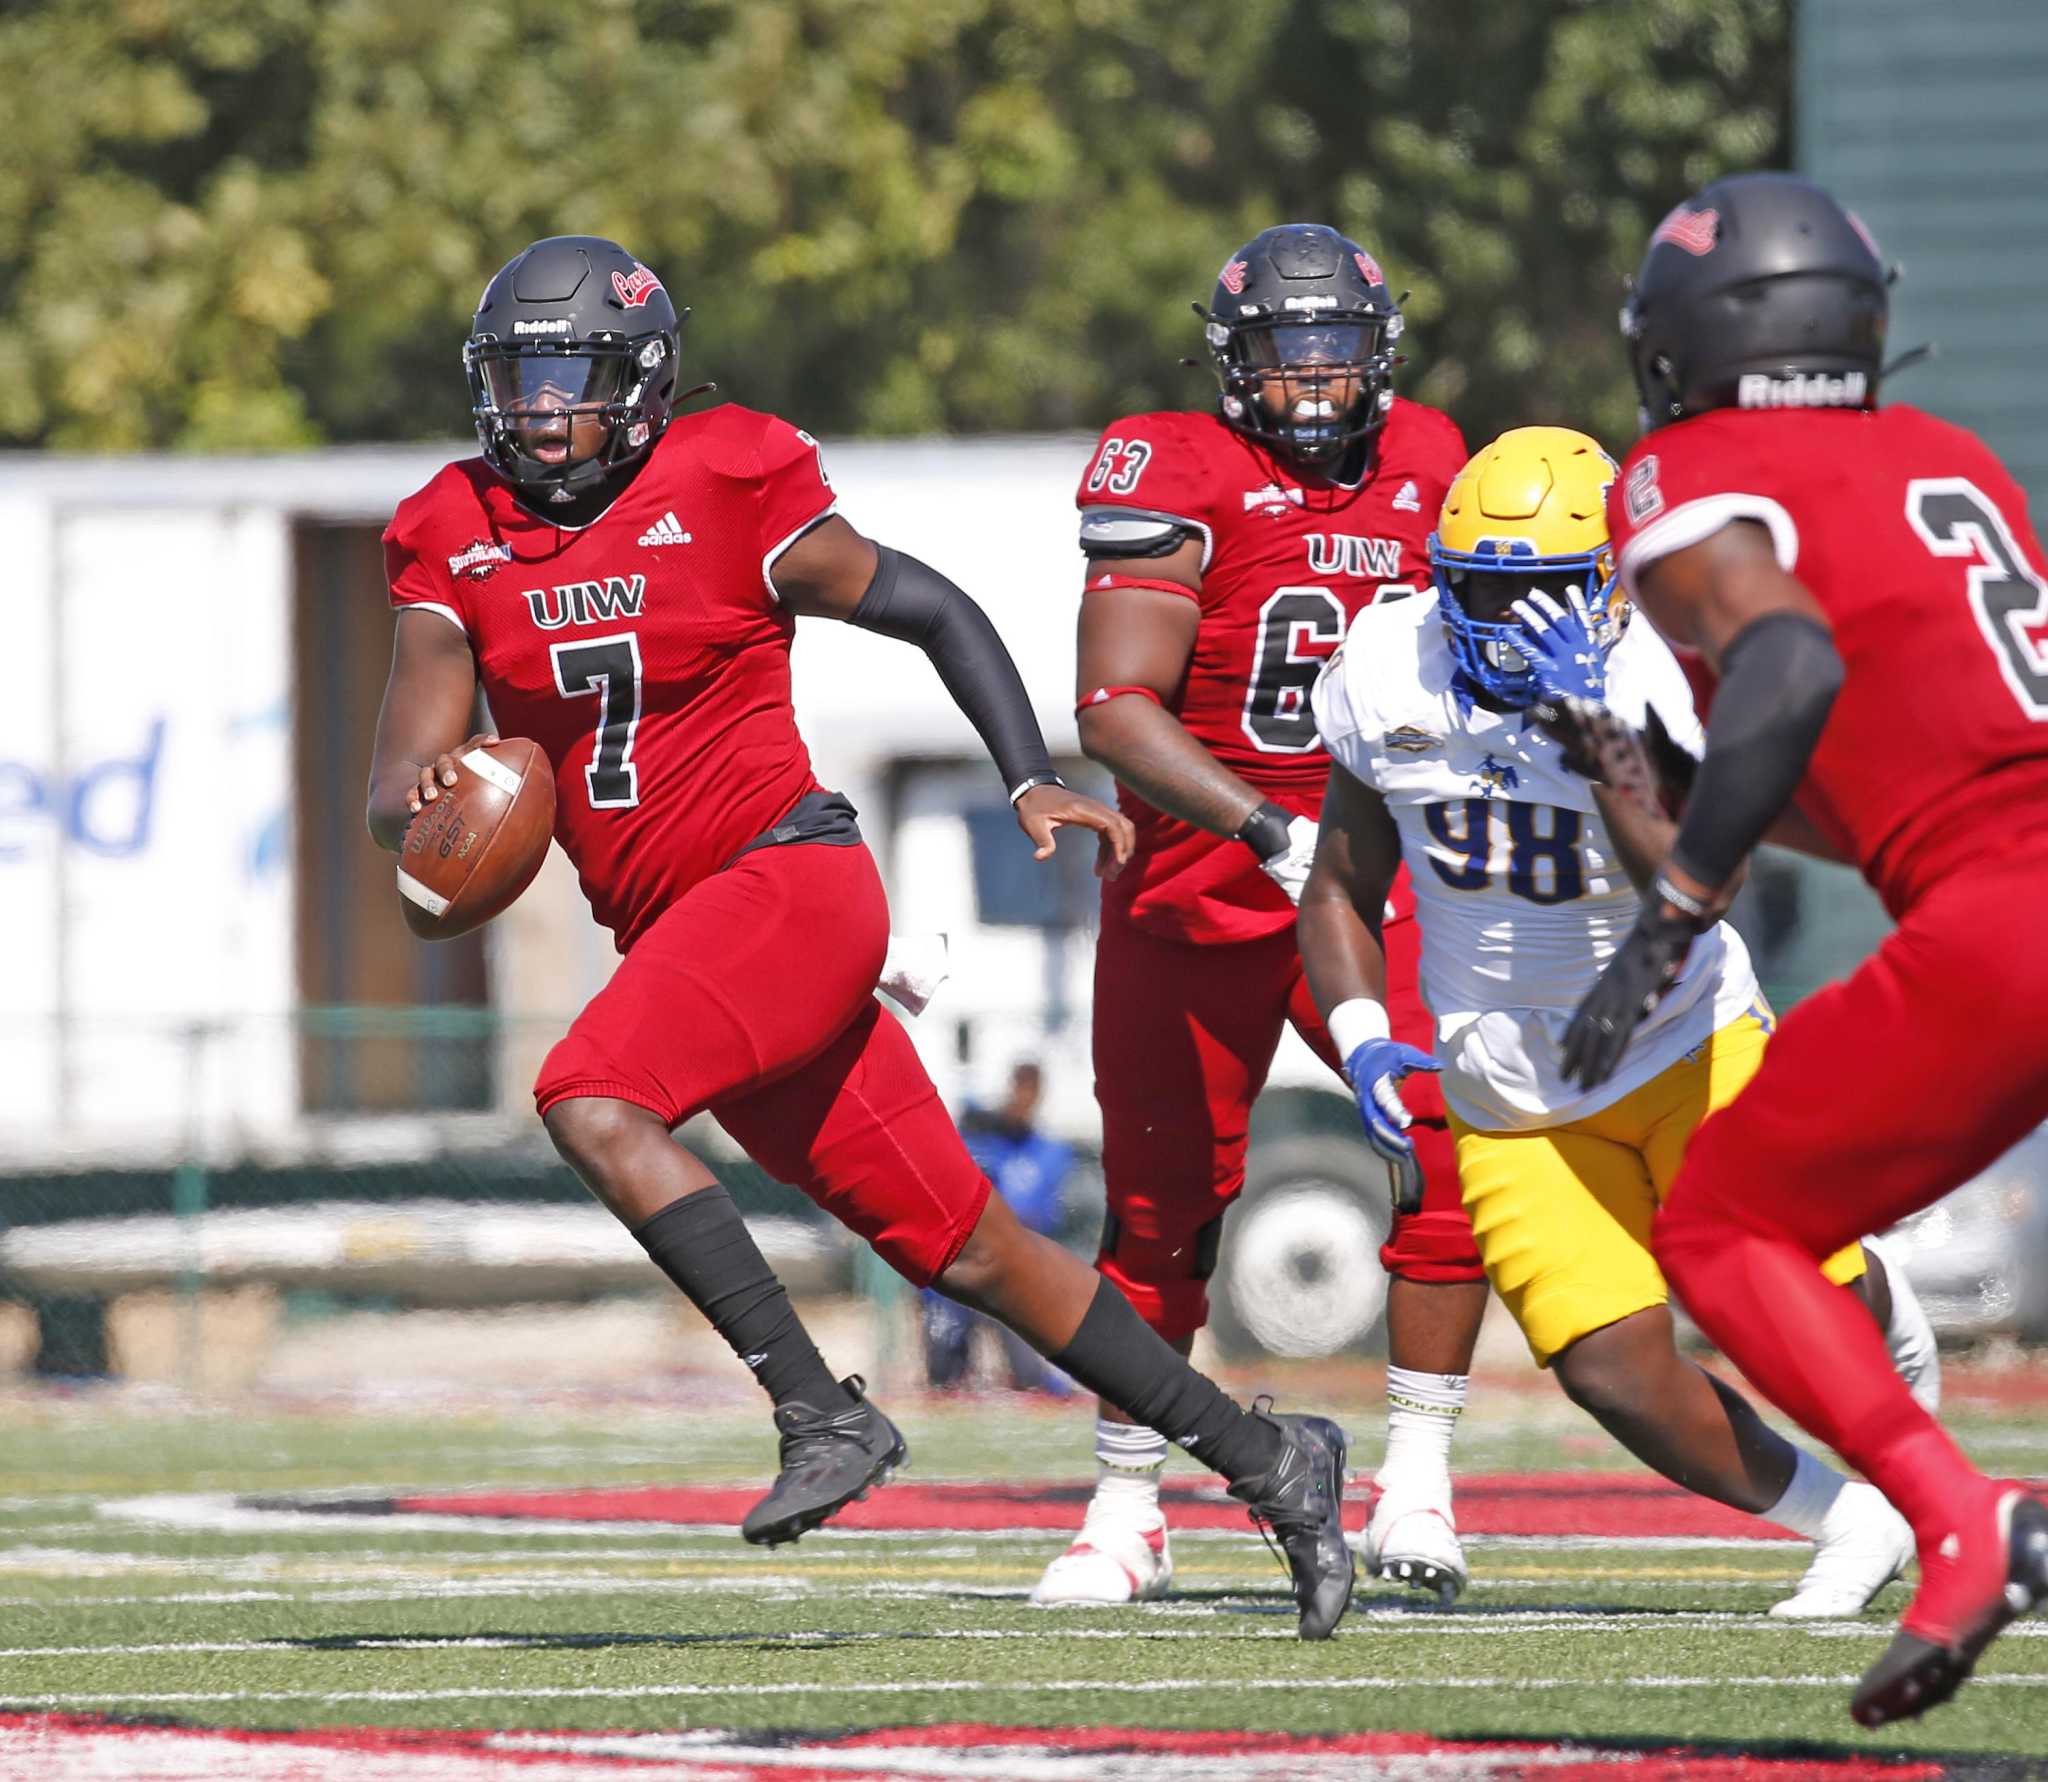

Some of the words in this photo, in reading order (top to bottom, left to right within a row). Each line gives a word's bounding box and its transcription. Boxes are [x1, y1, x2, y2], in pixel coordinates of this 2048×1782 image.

[513, 319, 567, 335] Riddell
[1738, 371, 1867, 409] Riddell
[1086, 437, 1152, 495] 63
[1623, 454, 1665, 528] 2
[637, 530, 692, 547] adidas
[1304, 534, 1402, 578] UIW
[521, 574, 646, 630] UIW
[1905, 476, 2048, 723] 2
[1241, 585, 1418, 754] 6
[549, 631, 643, 811] 7
[1424, 798, 1585, 905] 98
